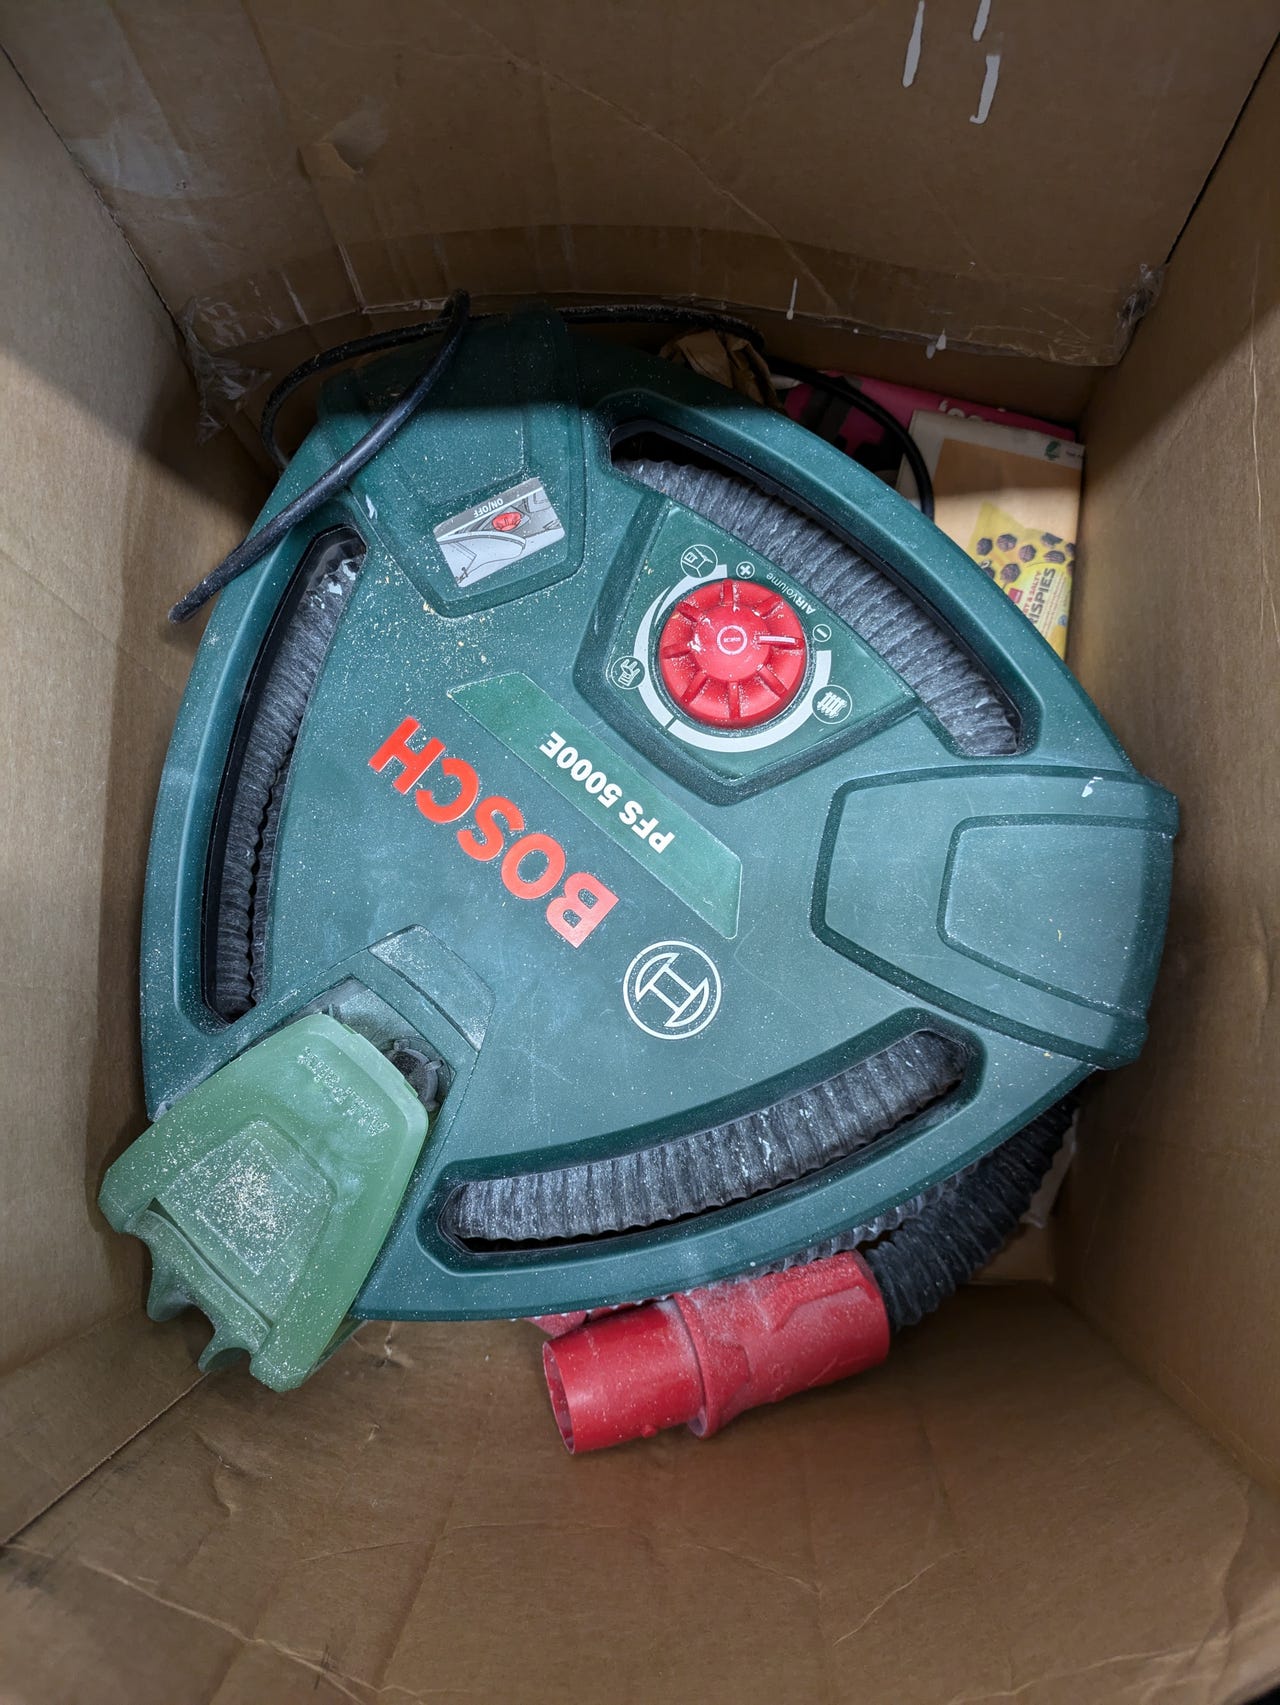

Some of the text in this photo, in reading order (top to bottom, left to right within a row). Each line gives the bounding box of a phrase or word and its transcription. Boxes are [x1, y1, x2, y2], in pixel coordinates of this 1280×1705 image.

[473, 498, 504, 518] ON/OFF
[766, 572, 816, 615] AIRVolume
[368, 715, 620, 949] BOSCH
[539, 730, 676, 854] PFS 5000E
